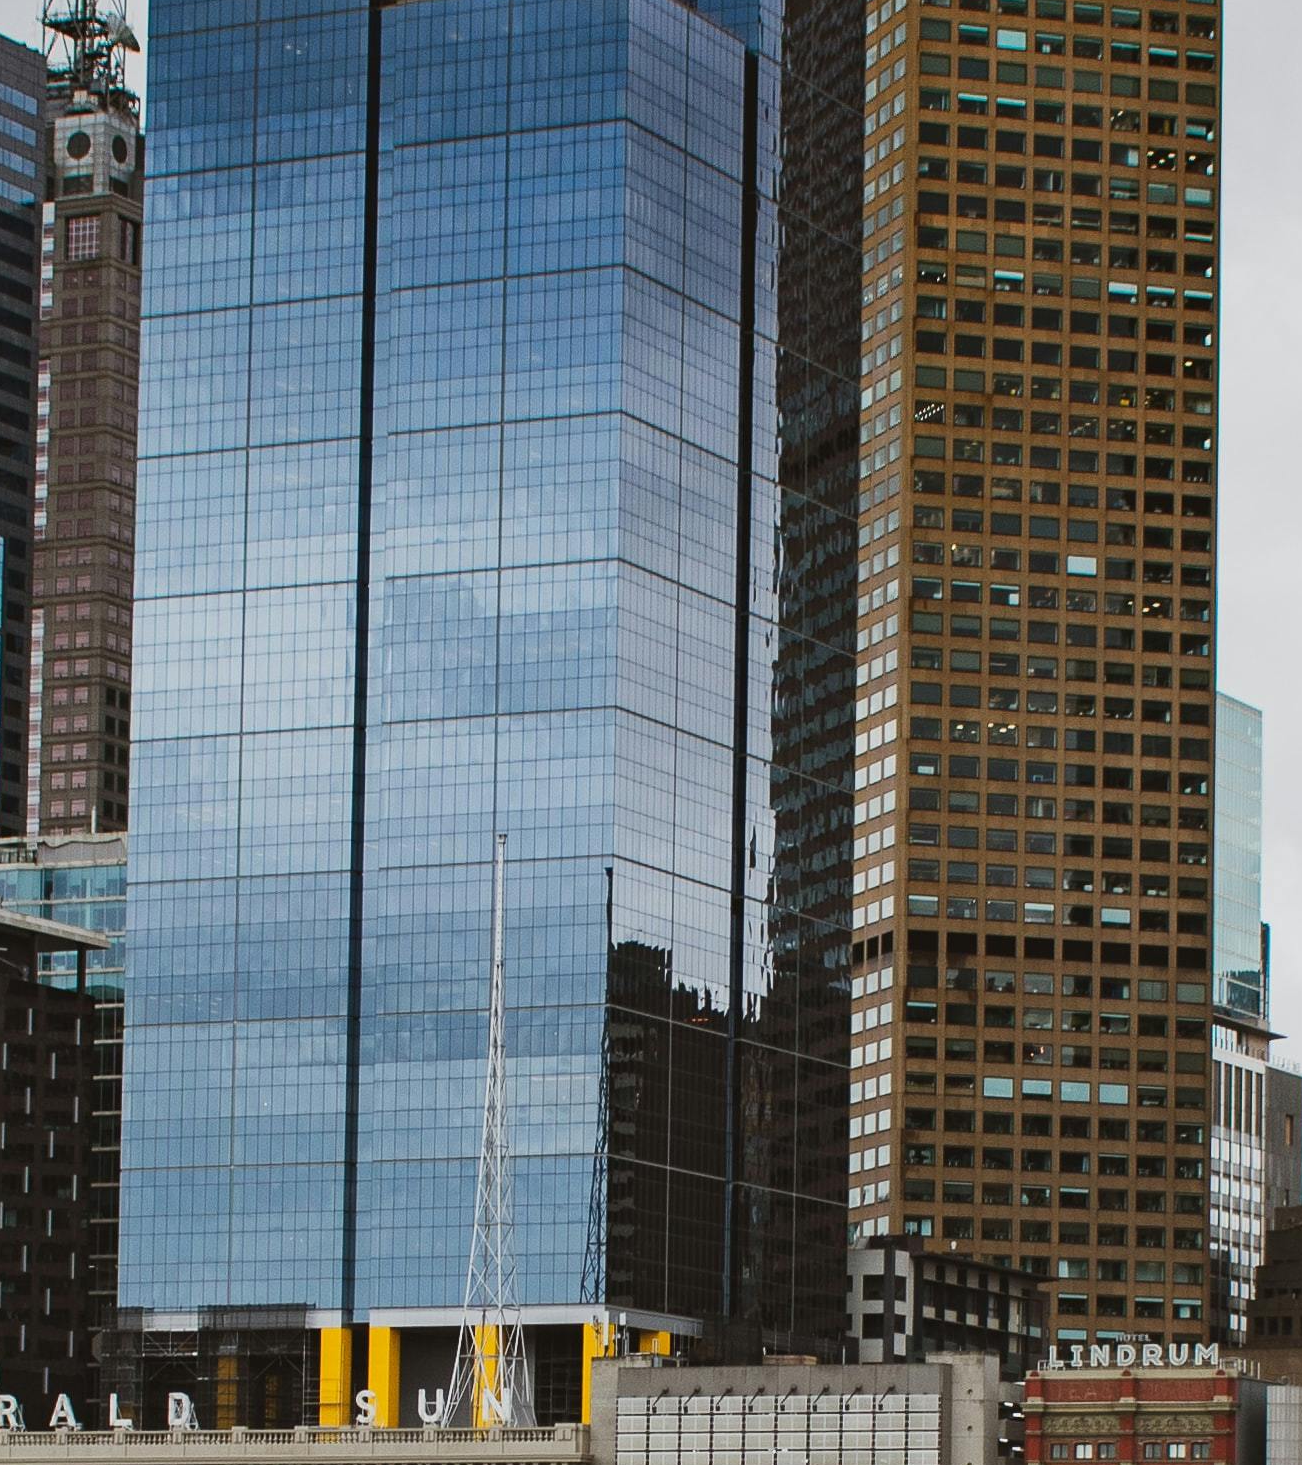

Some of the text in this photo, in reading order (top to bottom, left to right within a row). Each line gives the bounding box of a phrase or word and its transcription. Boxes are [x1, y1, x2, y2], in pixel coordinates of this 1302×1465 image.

[1115, 1334, 1152, 1343] HOTEL
[1049, 1343, 1219, 1367] LINDRUM
[354, 1387, 511, 1424] SUN
